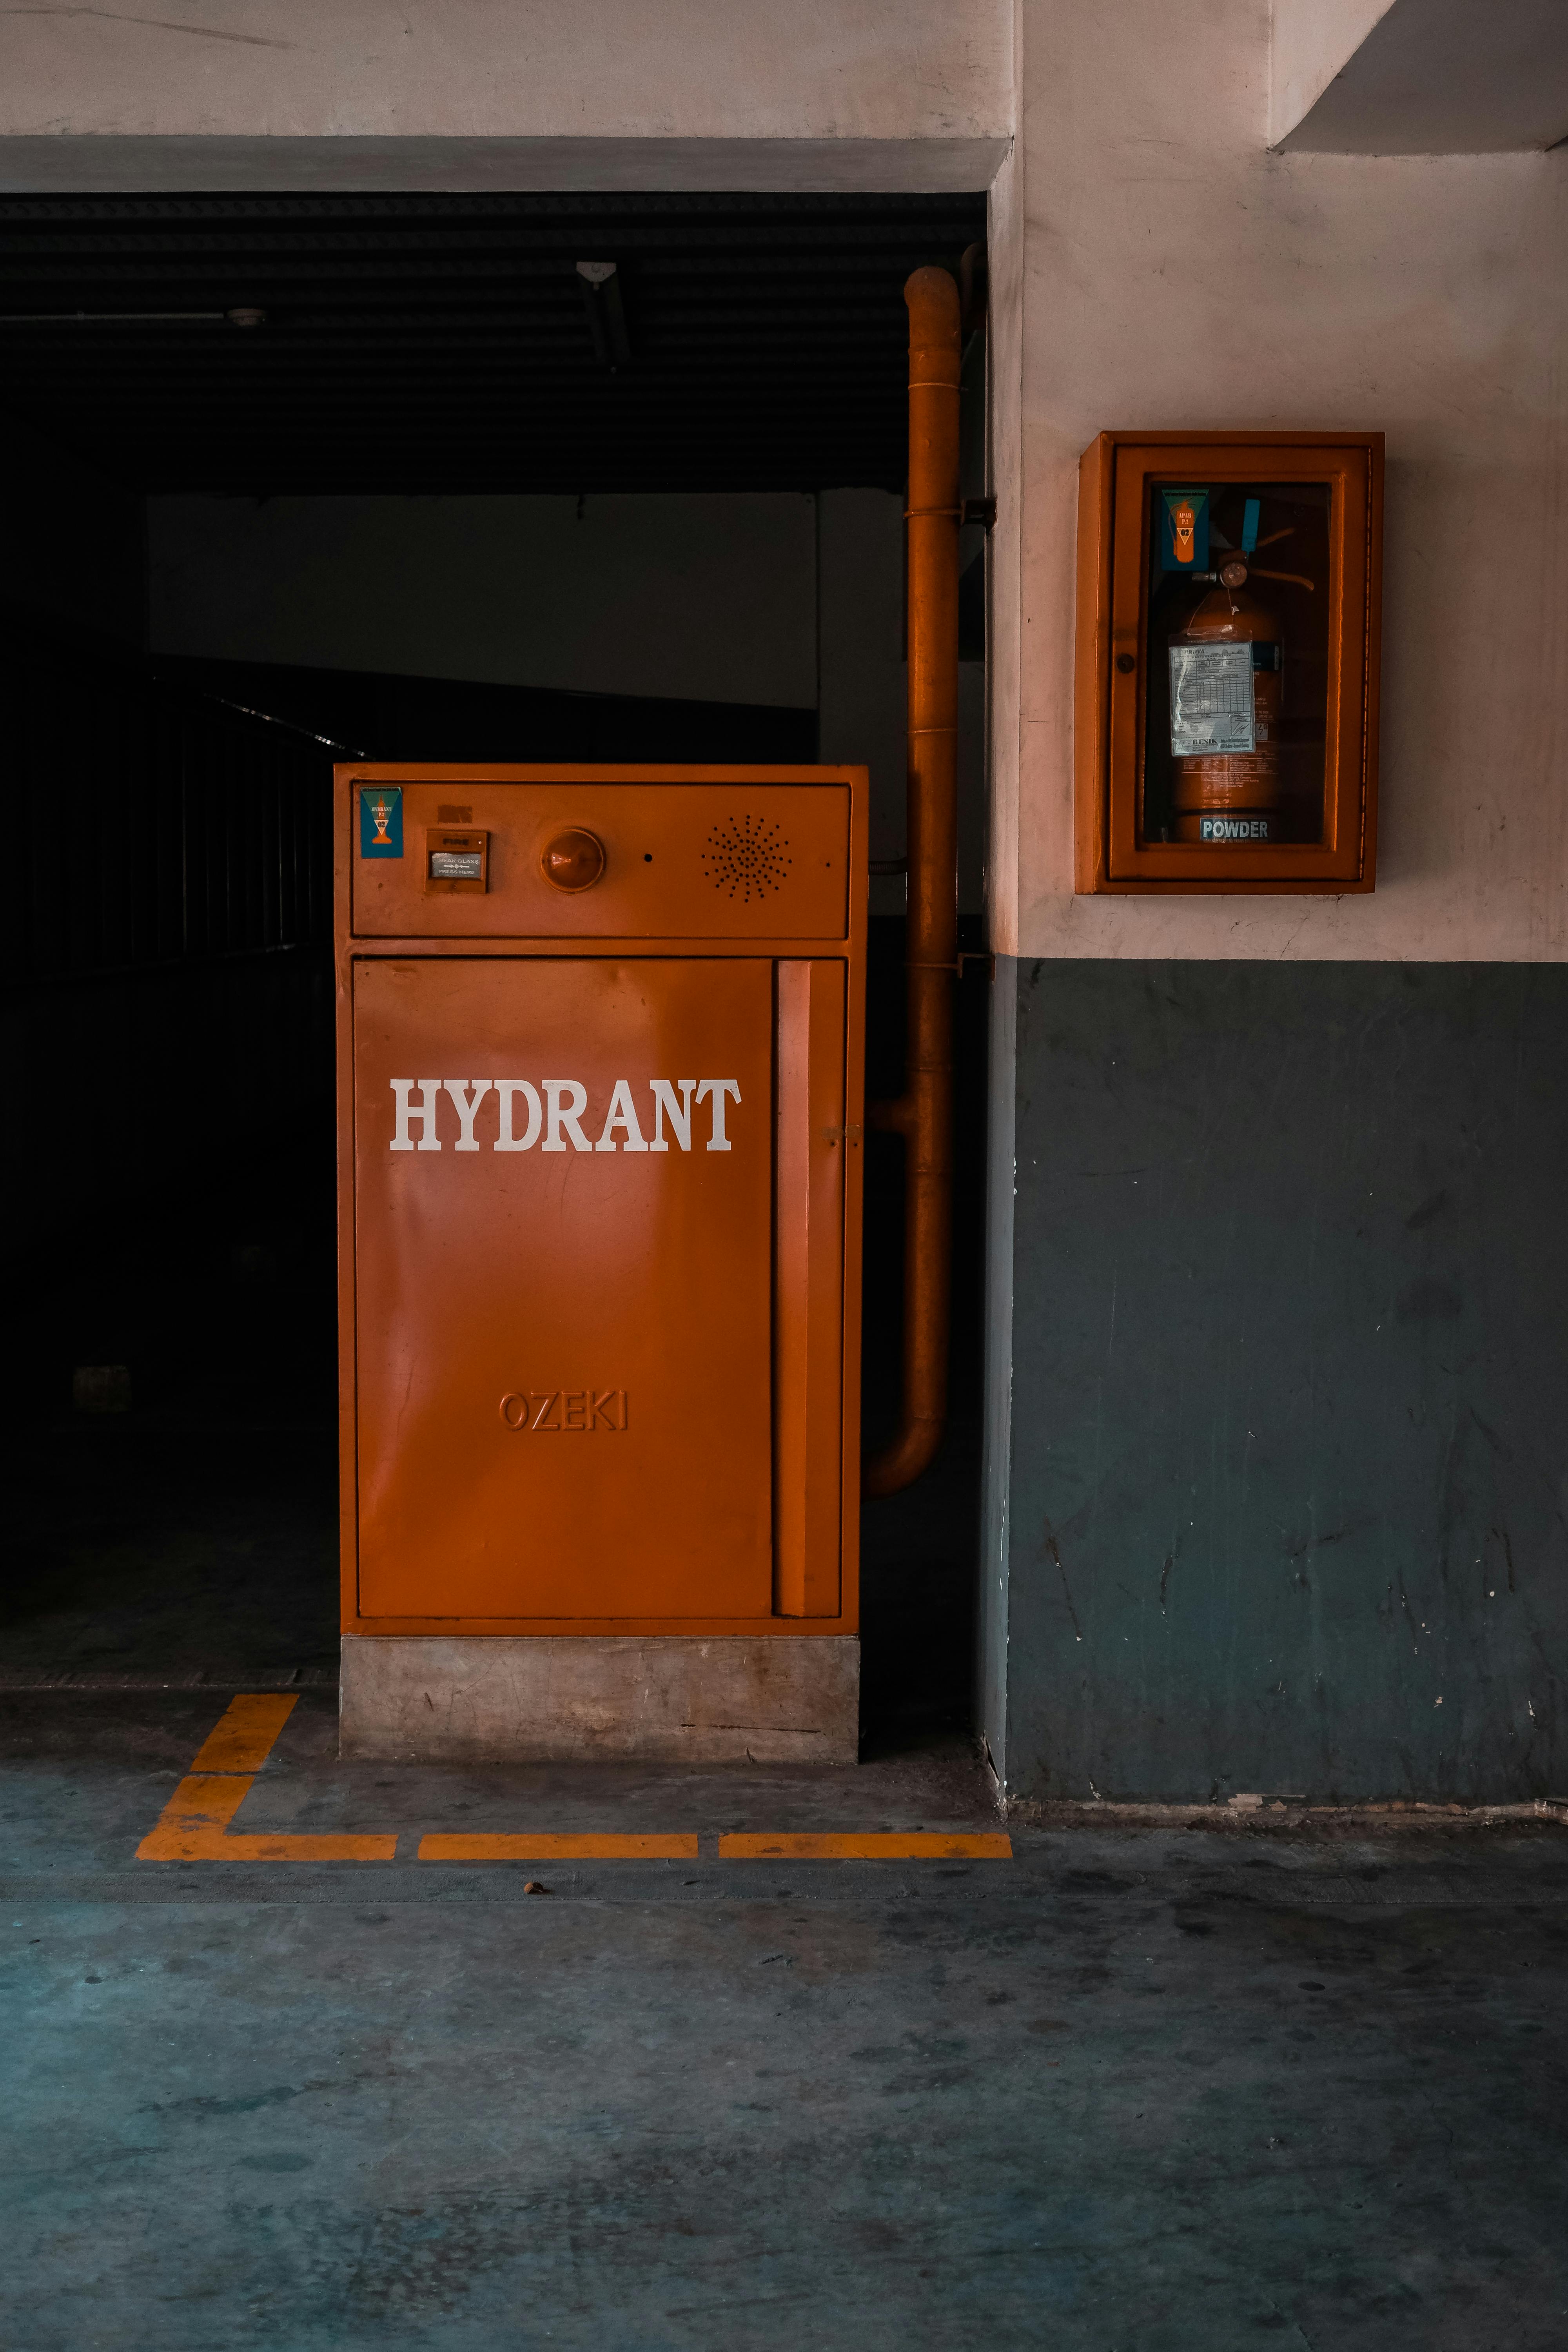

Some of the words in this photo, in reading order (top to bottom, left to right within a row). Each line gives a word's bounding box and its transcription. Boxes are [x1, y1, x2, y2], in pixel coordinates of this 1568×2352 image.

[1203, 821, 1268, 837] POWDER
[390, 1079, 742, 1151] HYDRANT
[499, 1390, 628, 1431] OZEKI
